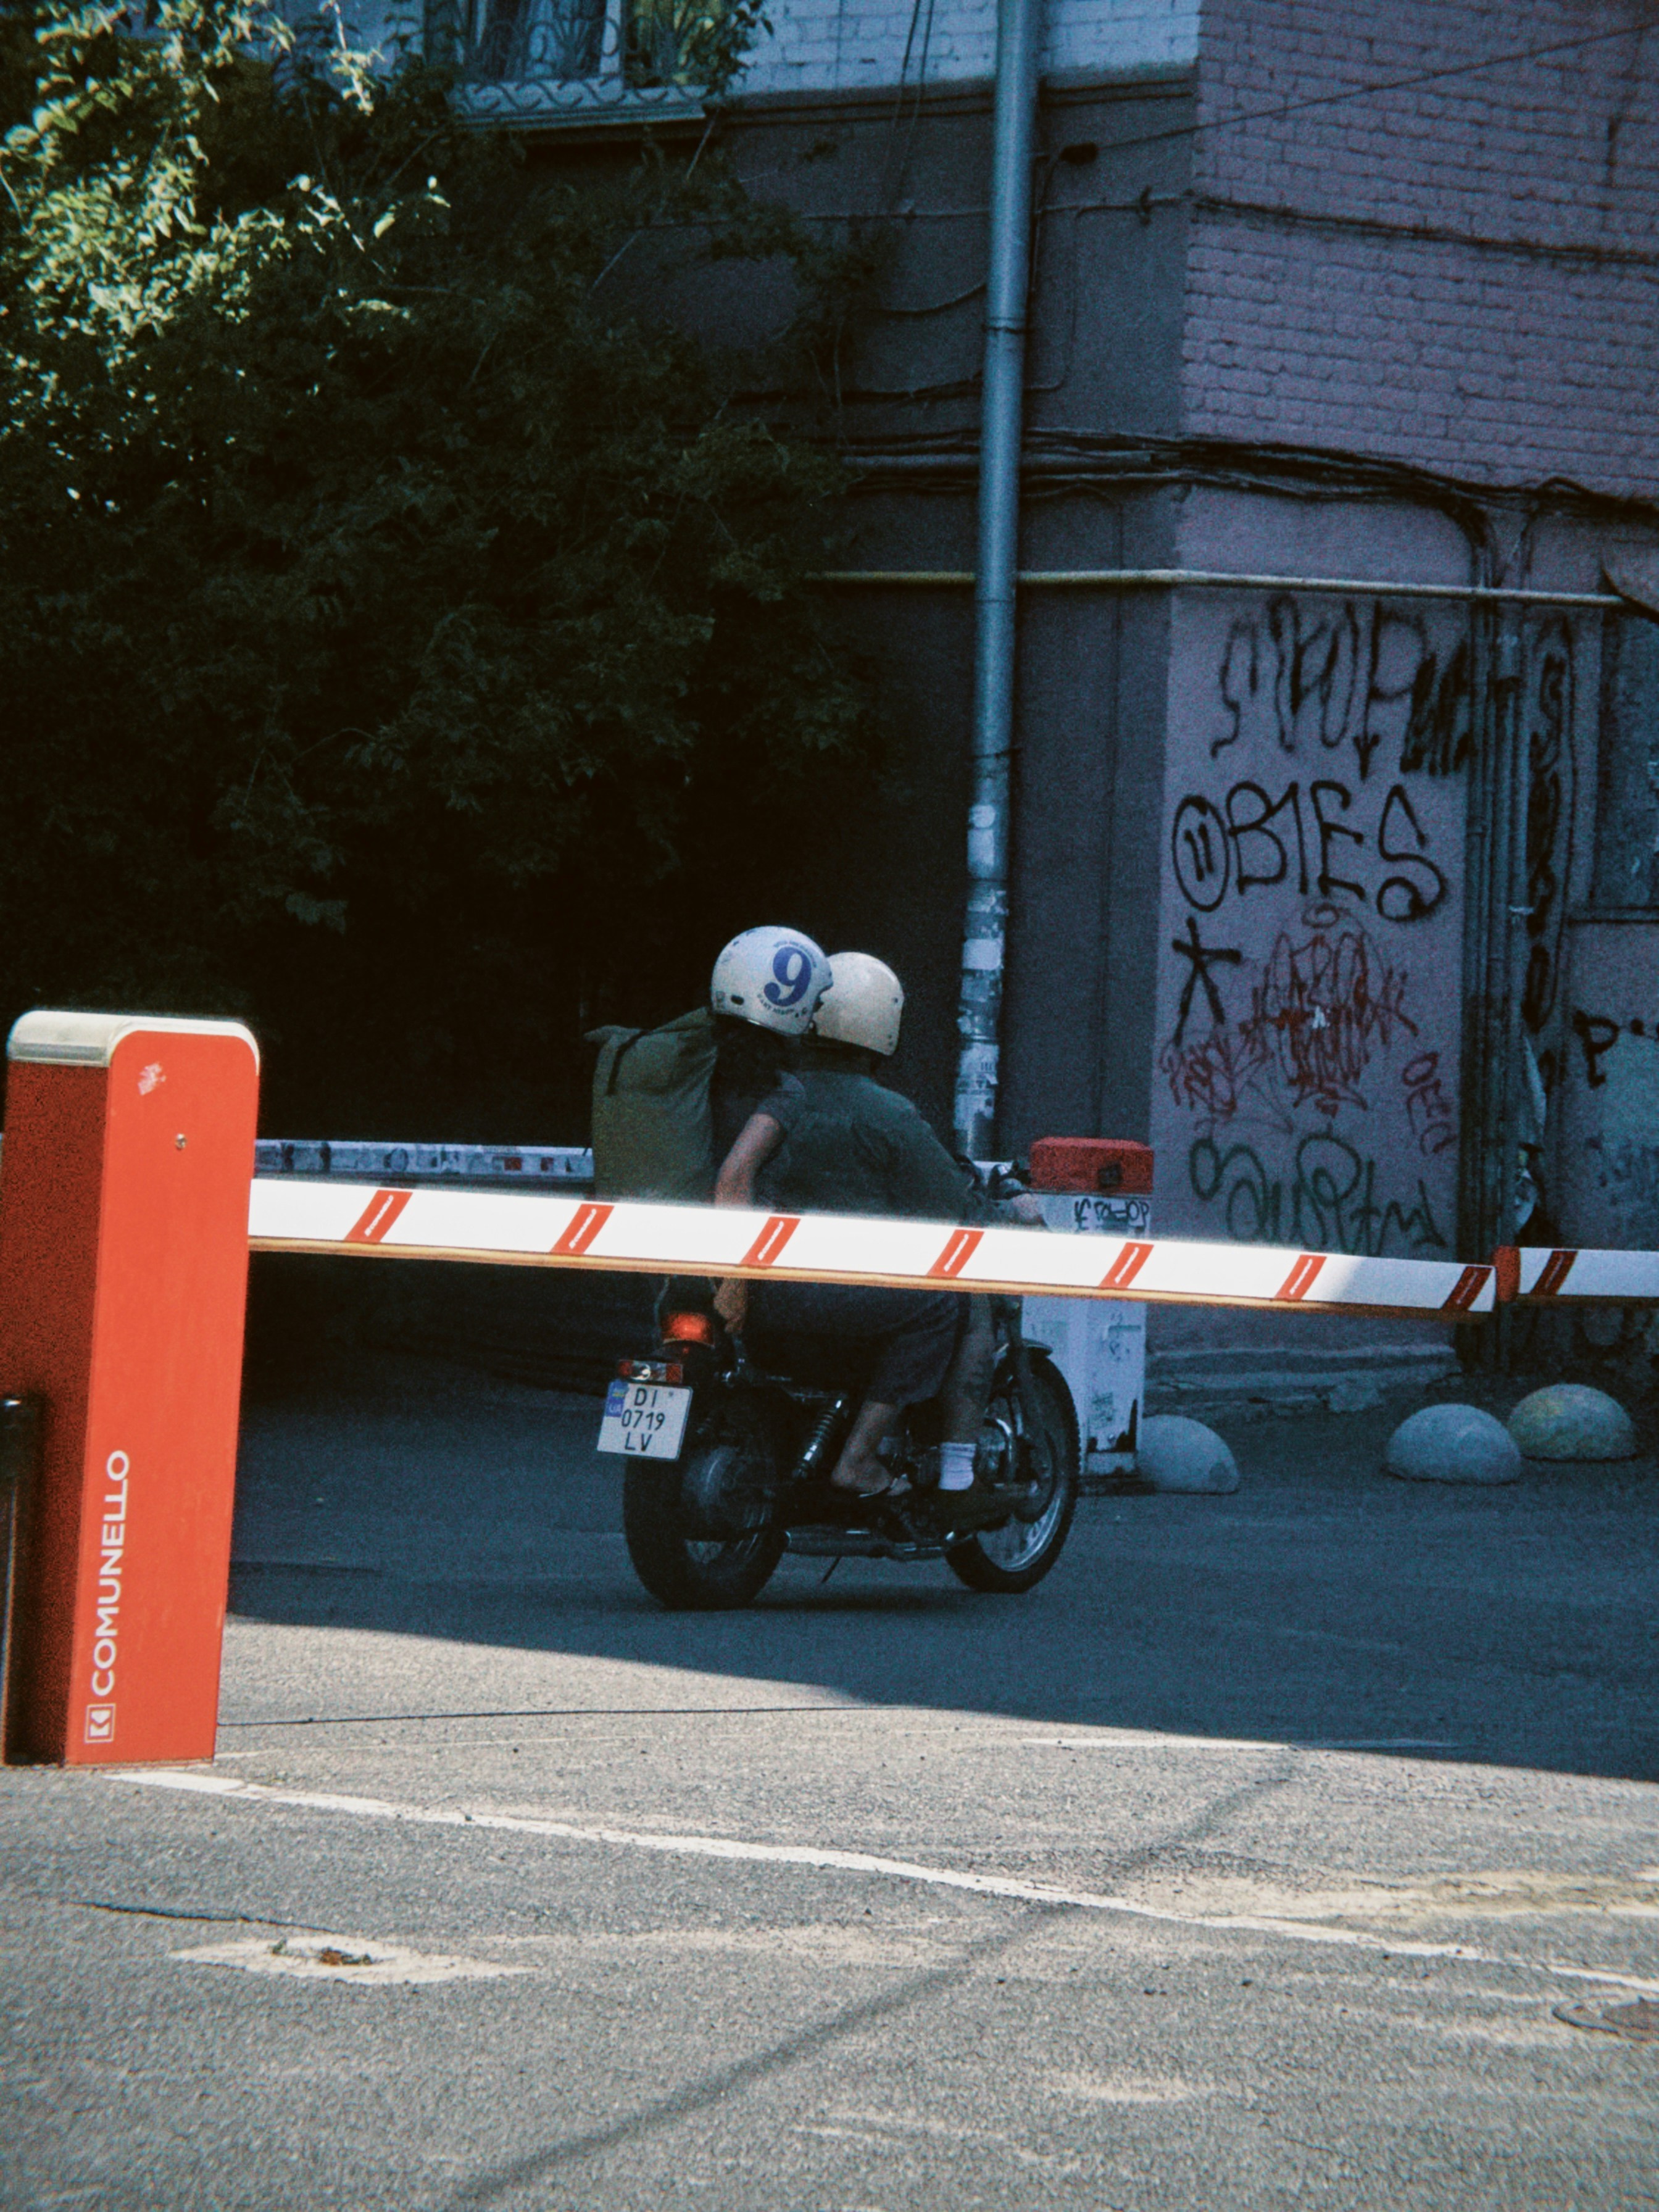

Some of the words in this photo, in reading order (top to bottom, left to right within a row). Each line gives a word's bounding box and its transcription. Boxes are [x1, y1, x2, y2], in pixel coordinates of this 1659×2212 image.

[763, 946, 812, 1007] 9
[634, 1387, 658, 1408] DI
[621, 1409, 665, 1431] 0719
[624, 1431, 653, 1451] LV
[91, 1450, 130, 1696] COMUNELLO
